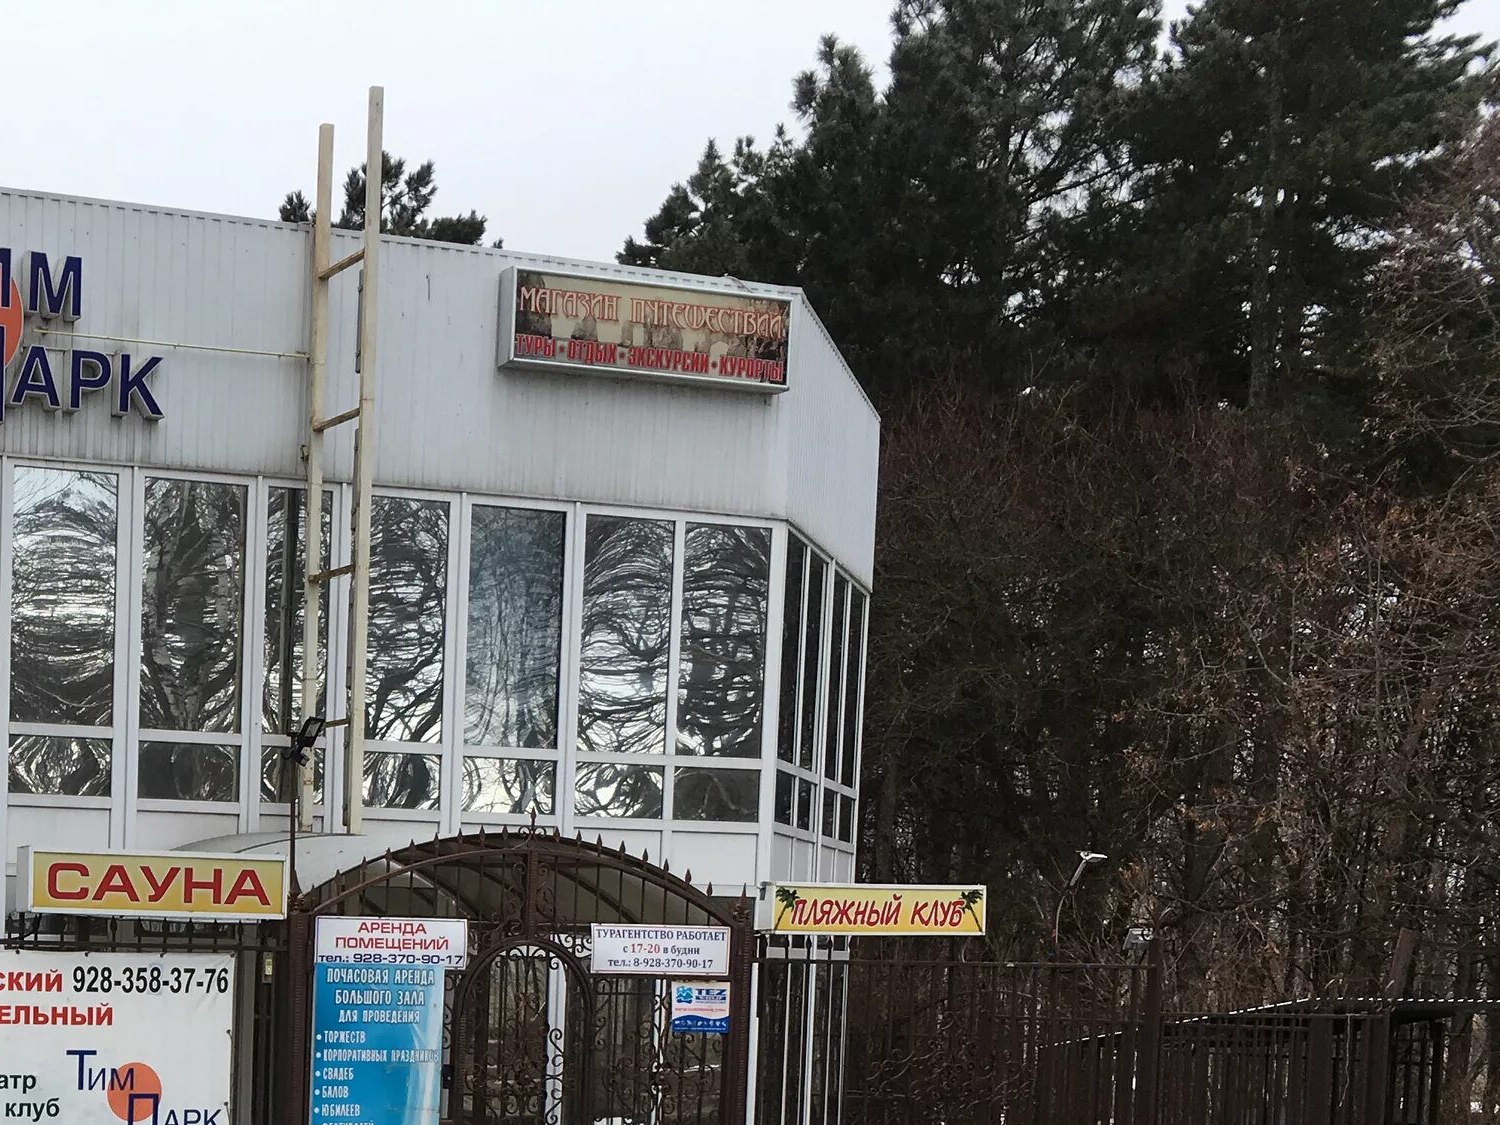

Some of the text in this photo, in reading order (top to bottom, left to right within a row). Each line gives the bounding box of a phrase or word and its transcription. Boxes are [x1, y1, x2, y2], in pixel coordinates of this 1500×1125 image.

[518, 286, 620, 322] МАГАЗИН
[515, 333, 784, 381] ТУРЫ ОТДЫХ ЭКСКУРСИИ КУРОРТЫ
[48, 862, 271, 906] САУНА
[790, 893, 966, 927] ПЛЯЖНЫЙ КЛУБ
[358, 922, 427, 936] АРЕНДА
[596, 928, 727, 941] ТУРАГЕНТСТВО РАБОТАЕТ
[335, 936, 449, 951] ПОМЕЩЕНИЙ
[631, 944, 660, 954] 17-20
[663, 946, 668, 954] в
[670, 944, 700, 956] будни
[318, 953, 463, 965] тел.: 928-370-90-17
[633, 958, 714, 969] 8-928-370-90-17
[73, 966, 229, 994] 928-358-37-76
[326, 968, 435, 985] ПОЧАСОВАЯ АРЕНДА
[335, 990, 425, 1006] БОЛЬШОГО ЗАЛА
[338, 1010, 420, 1024] ДЛЯ ПРОВЕДЕНИЯ
[324, 1031, 366, 1043] ТОРЖЕСТВ
[323, 1049, 387, 1062] КОРПОРАТИВНЫХ
[322, 1068, 354, 1080] СВАДЕБ
[322, 1086, 349, 1098] БАЛОВ
[5, 1097, 60, 1123] клуб
[321, 1104, 360, 1116] ЮБИЛЕЕВ
